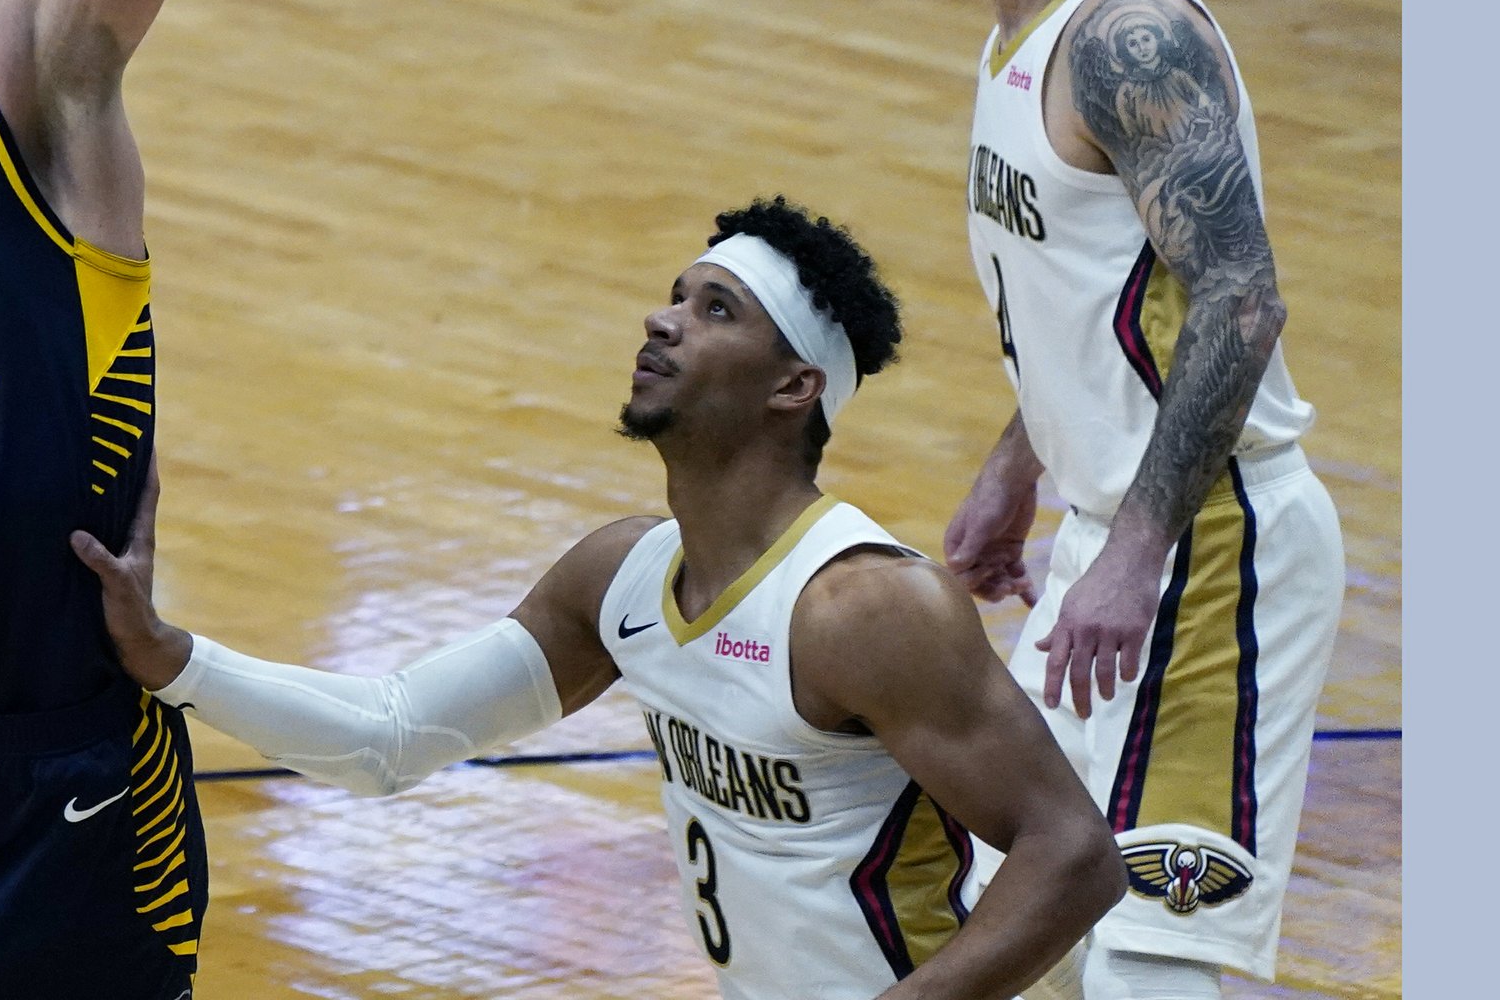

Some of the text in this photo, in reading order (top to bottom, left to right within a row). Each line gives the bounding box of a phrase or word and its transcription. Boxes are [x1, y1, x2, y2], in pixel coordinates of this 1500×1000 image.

[714, 633, 770, 663] ibotta
[668, 715, 812, 824] ORLEANS
[686, 816, 733, 968] 3
